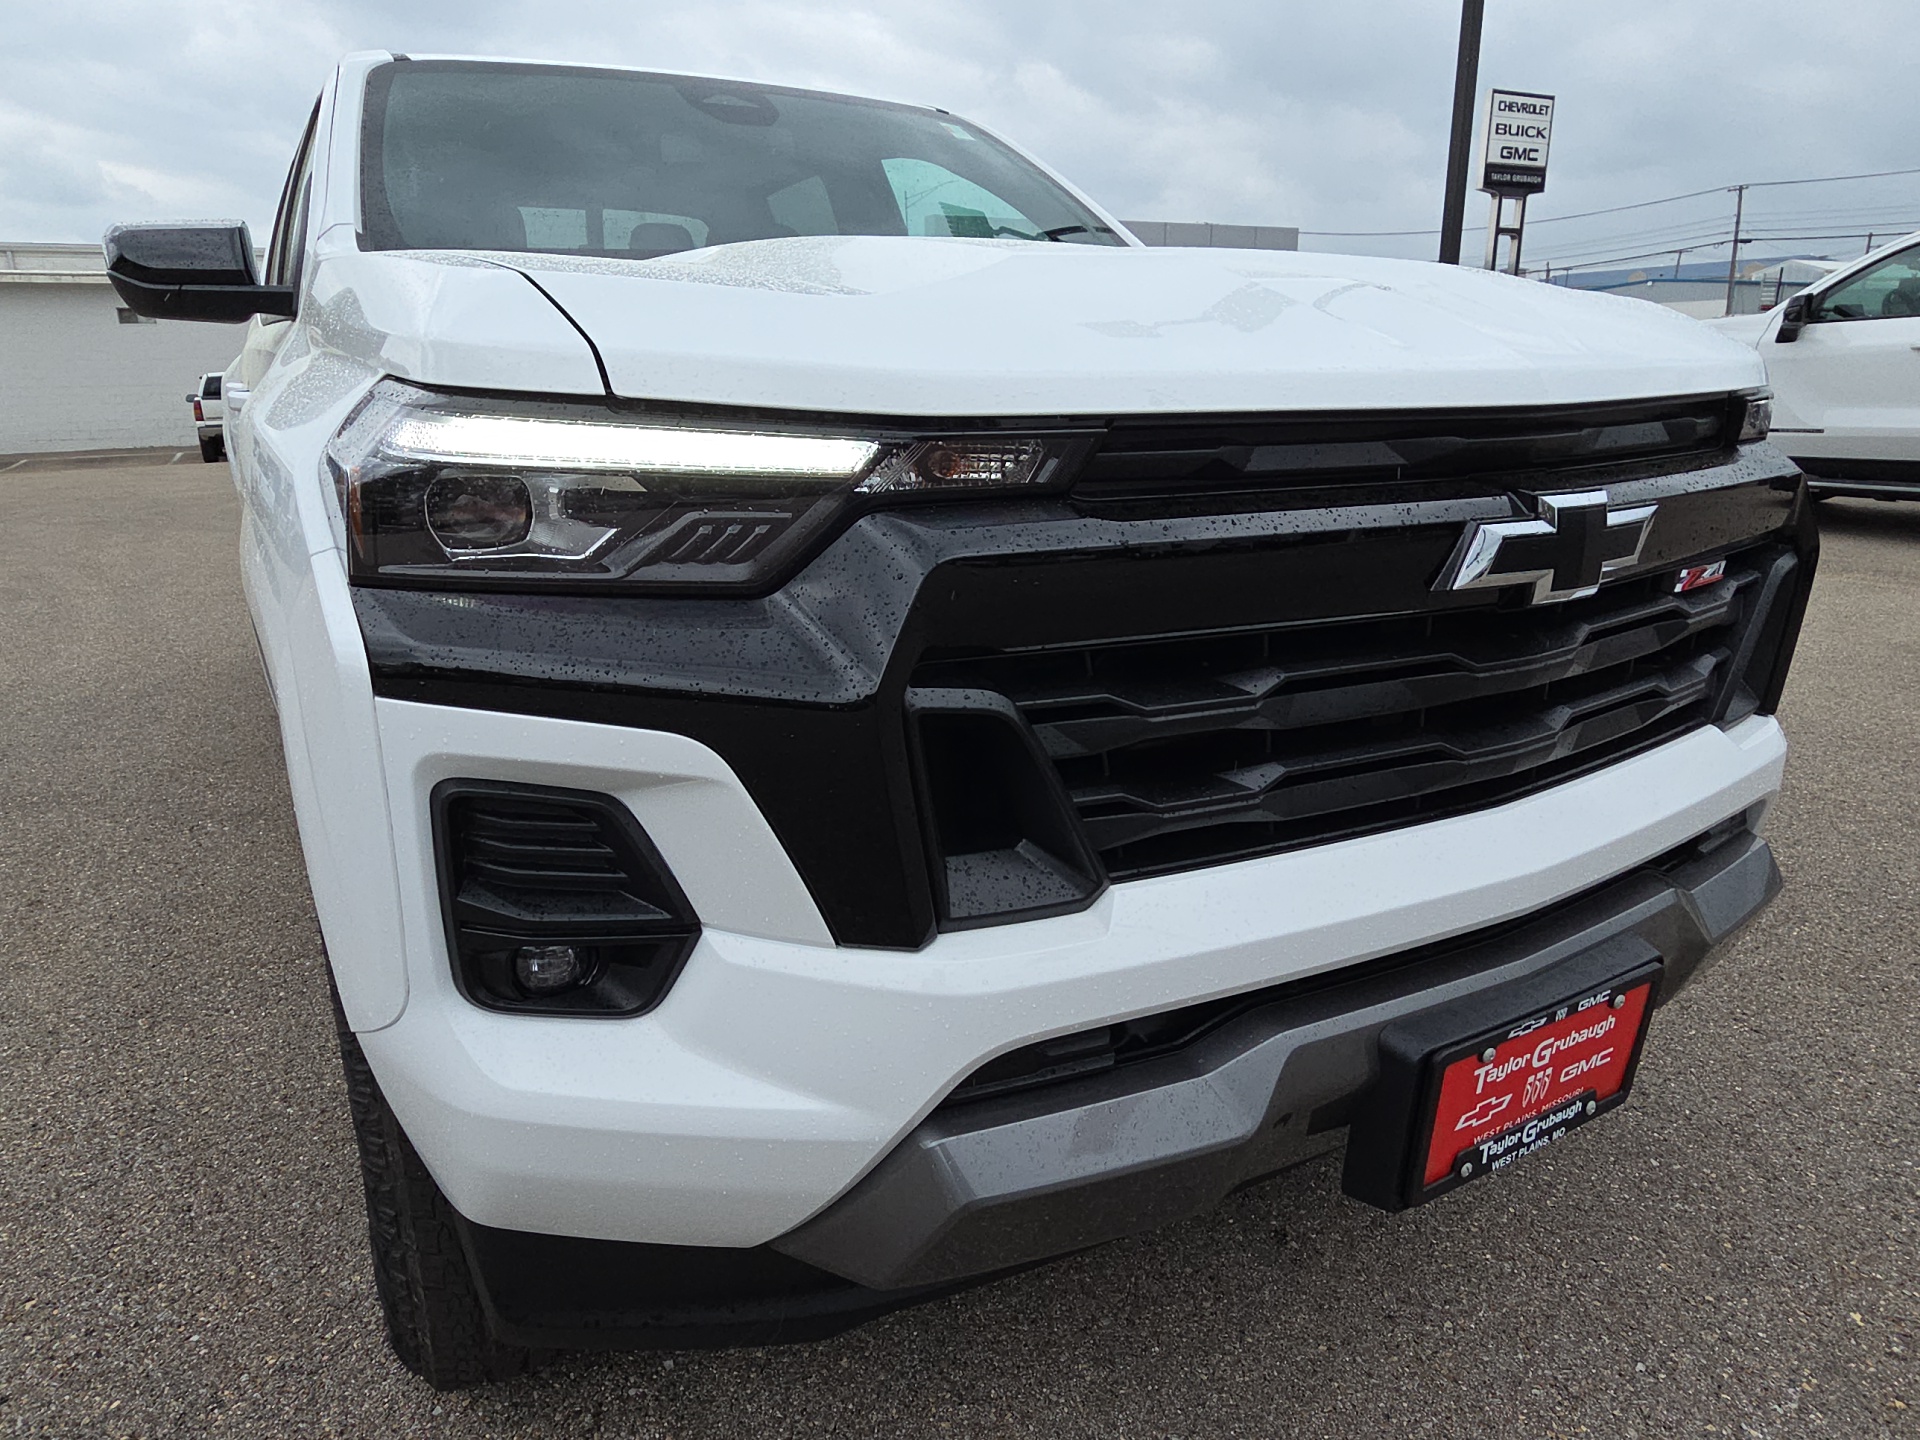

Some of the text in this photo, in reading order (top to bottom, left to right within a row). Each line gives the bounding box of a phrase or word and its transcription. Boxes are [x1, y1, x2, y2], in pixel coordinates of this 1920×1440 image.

[1498, 100, 1550, 116] CHEVROLET
[1495, 122, 1547, 139] BUICK
[1500, 145, 1539, 161] GMC
[1491, 172, 1511, 181] TAYLOR
[1578, 990, 1611, 1011] GMC
[1474, 1015, 1616, 1094] Taylor Grubaugh
[1560, 1047, 1614, 1083] GMC
[1473, 1126, 1501, 1145] WEST
[1541, 1086, 1584, 1112] MISSOURI
[1479, 1100, 1583, 1164] Taylor Grubaugh
[1491, 1151, 1518, 1171] WEST
[1552, 1127, 1566, 1140] MO
